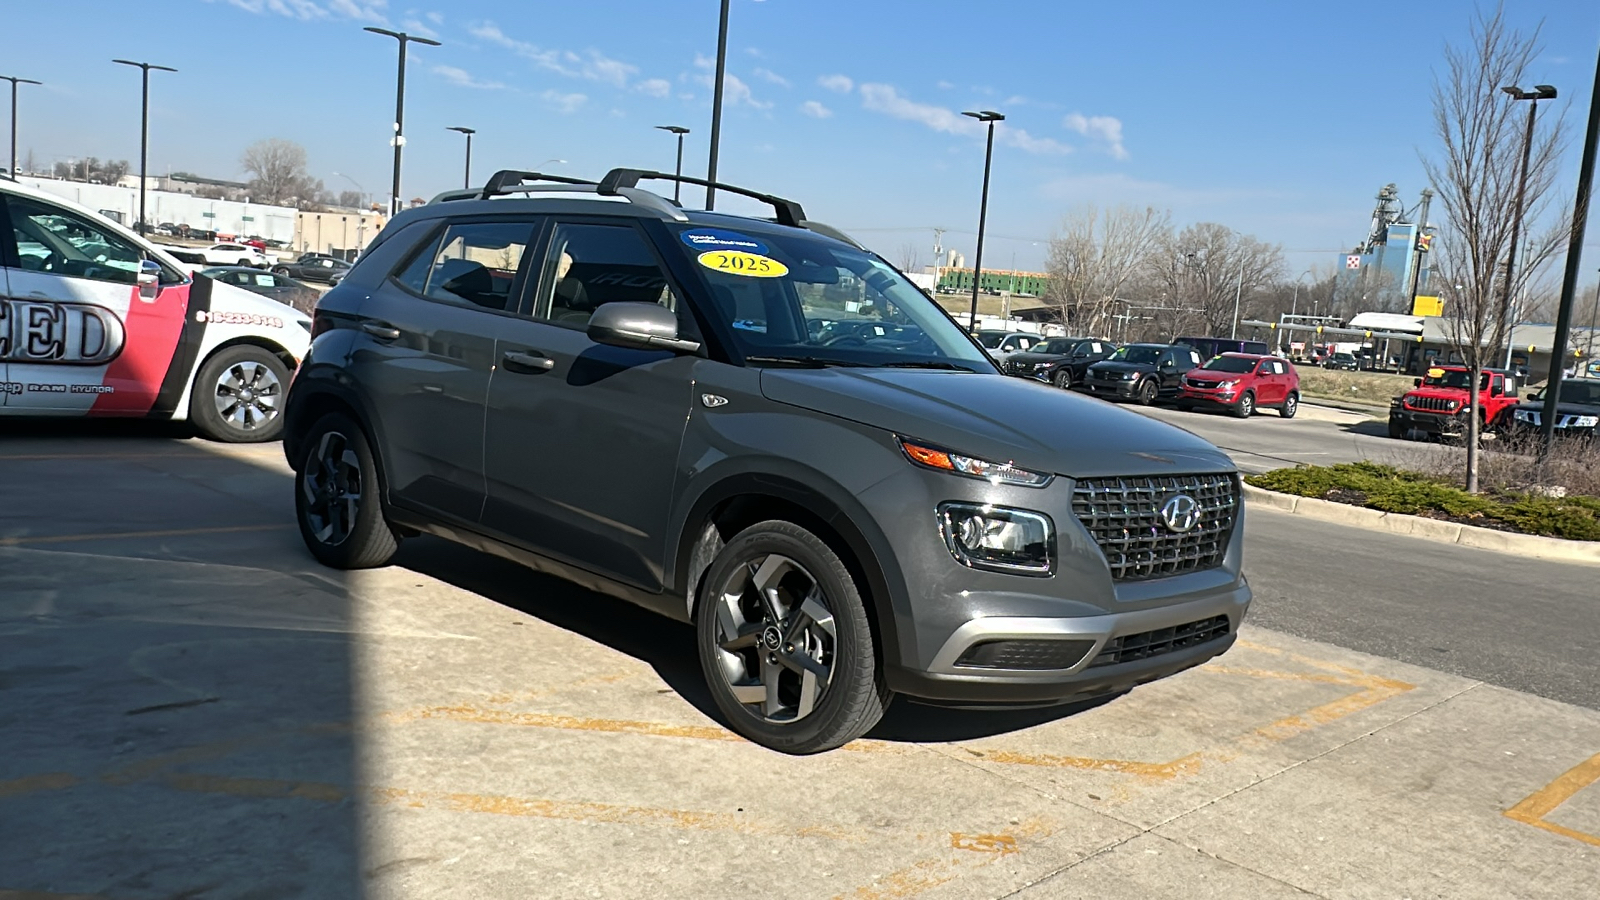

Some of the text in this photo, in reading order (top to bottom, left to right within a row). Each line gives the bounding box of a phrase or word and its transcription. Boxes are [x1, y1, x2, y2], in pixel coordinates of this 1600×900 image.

[717, 254, 770, 272] 2025
[28, 383, 66, 392] RAM
[70, 385, 114, 394] HYUNDAI
